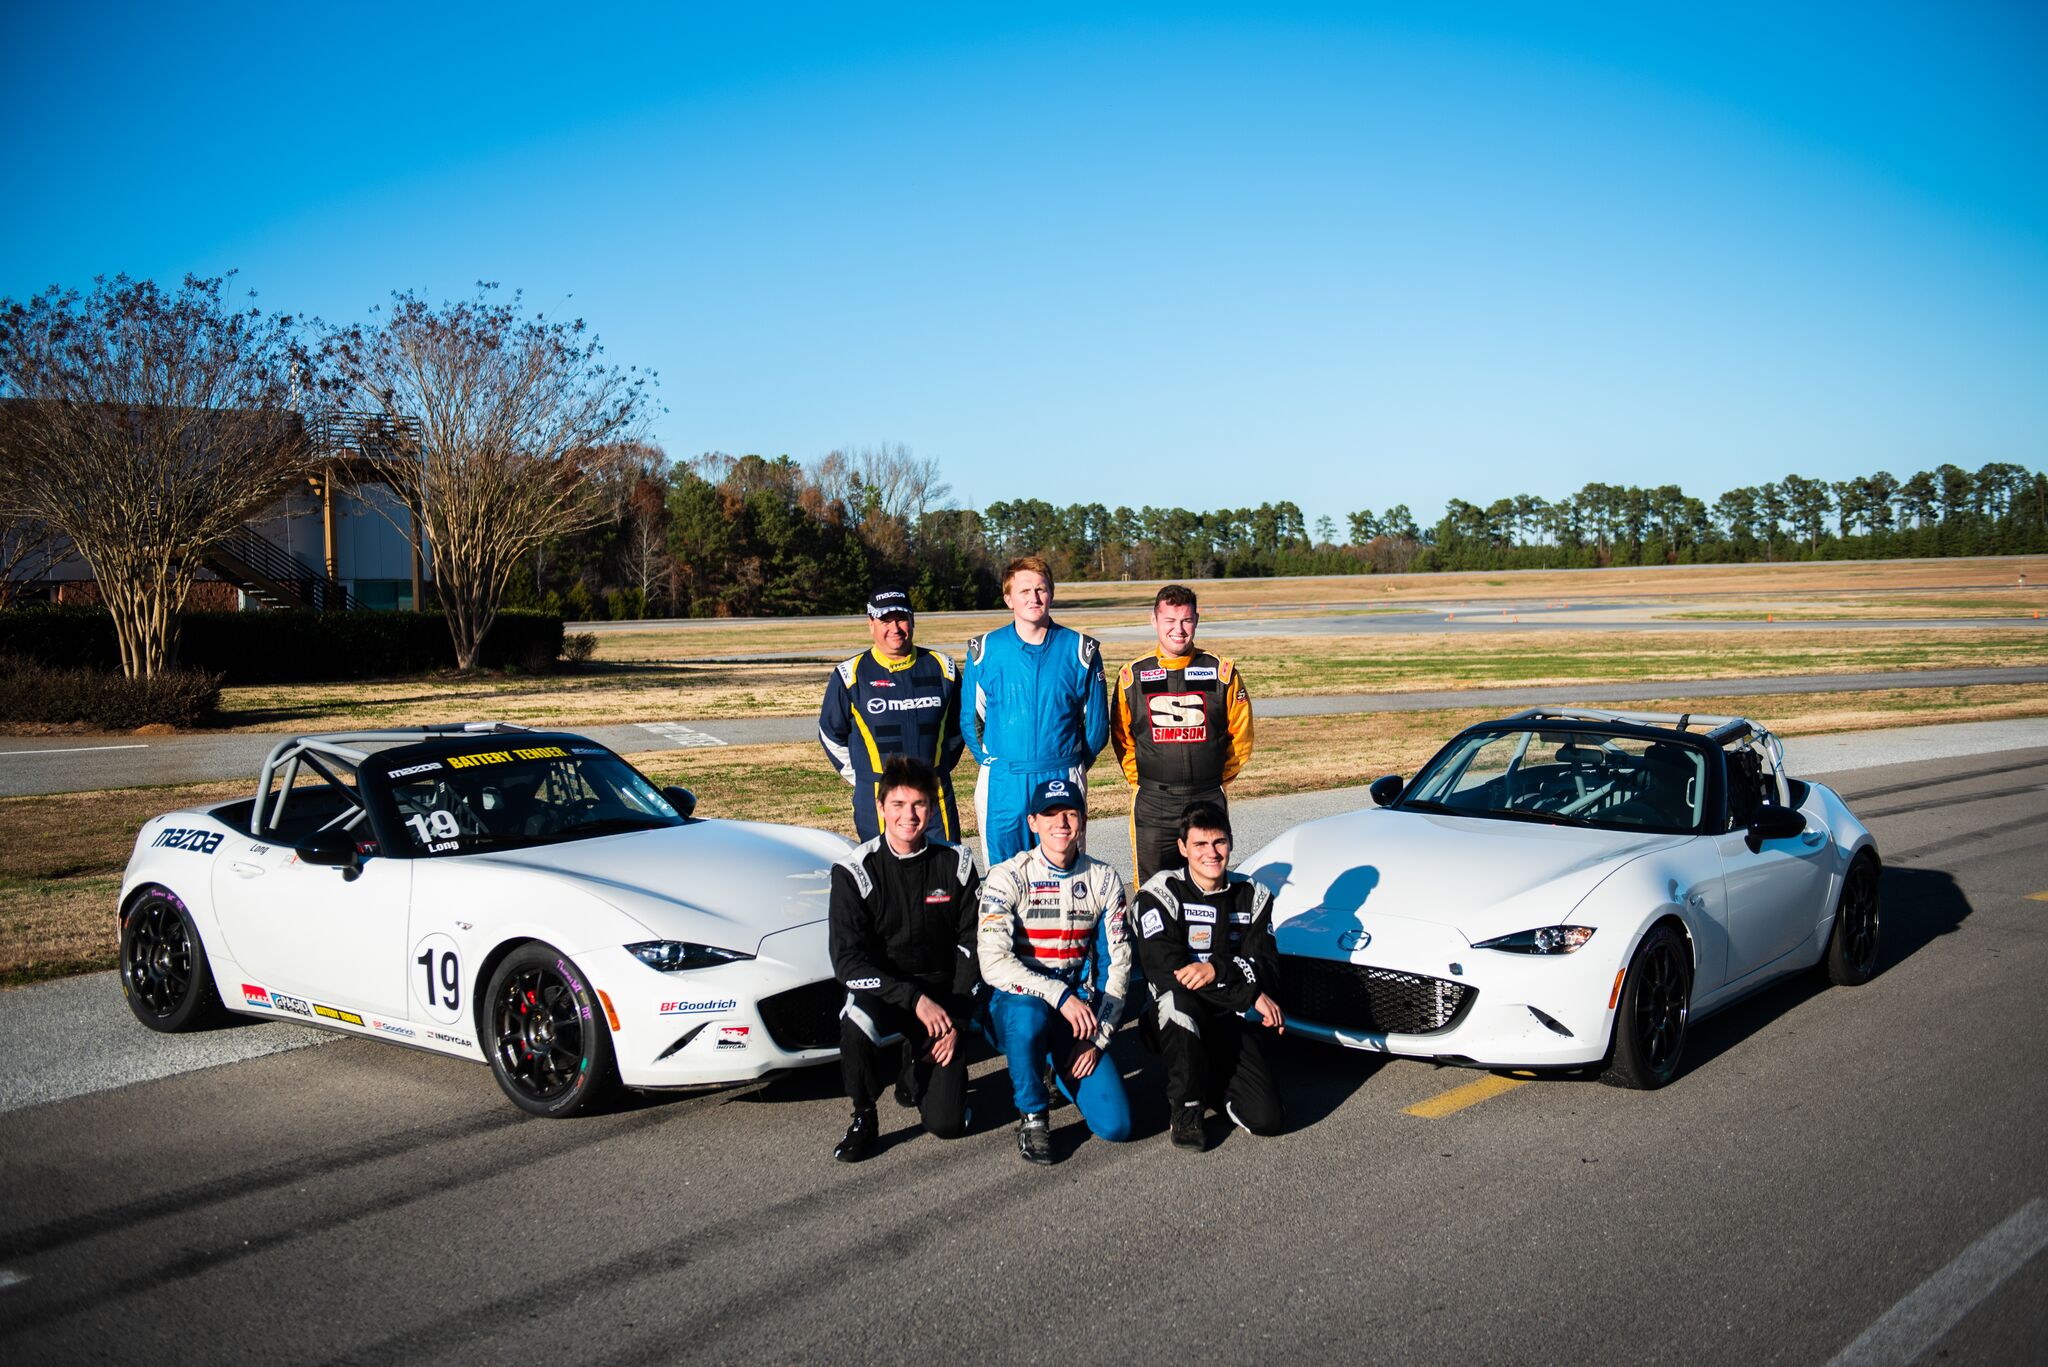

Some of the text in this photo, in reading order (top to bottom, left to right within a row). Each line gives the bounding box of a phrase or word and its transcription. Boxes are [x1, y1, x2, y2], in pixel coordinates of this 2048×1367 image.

[1141, 669, 1166, 677] SCCA
[888, 696, 942, 711] mazda
[1154, 727, 1205, 741] SIMPSON
[446, 746, 566, 770] BATTERY TENDER
[387, 762, 443, 779] mazda
[405, 810, 461, 844] 19
[151, 828, 225, 855] mazda
[428, 841, 460, 854] Long
[249, 843, 270, 856] Long
[1183, 907, 1215, 919] mazda
[417, 948, 460, 1011] 19
[660, 999, 737, 1012] BFGoodrich
[434, 1031, 473, 1047] INDYCAR
